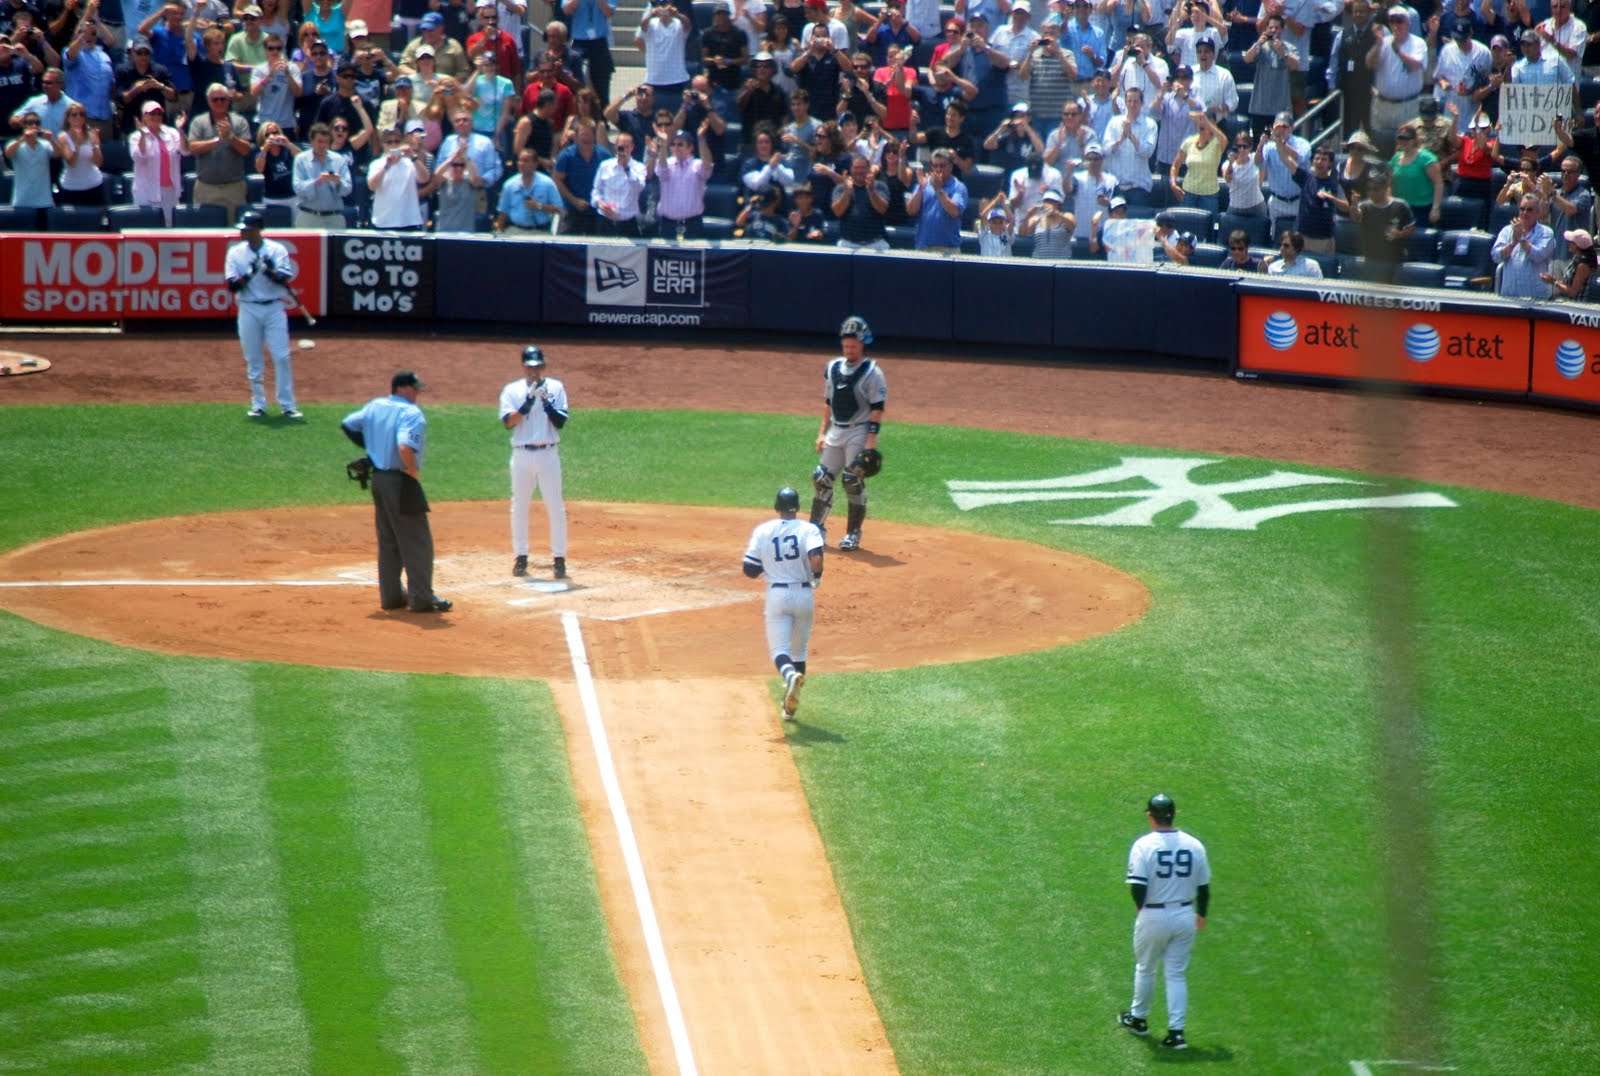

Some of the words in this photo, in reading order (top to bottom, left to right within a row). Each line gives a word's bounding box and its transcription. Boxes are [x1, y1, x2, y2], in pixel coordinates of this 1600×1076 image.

[344, 238, 422, 261] Gotta
[341, 263, 379, 287] Go
[385, 265, 419, 287] To
[653, 259, 696, 277] NEW
[653, 277, 696, 293] ERA
[23, 288, 181, 312] SPORTING
[353, 290, 413, 312] Mo's
[1317, 290, 1441, 312] YANKEES.COM
[588, 311, 701, 326] neweracap.com
[1304, 321, 1360, 349] at&t
[1447, 332, 1505, 360] at&t
[771, 534, 800, 562] 13
[1156, 849, 1193, 878] 59
